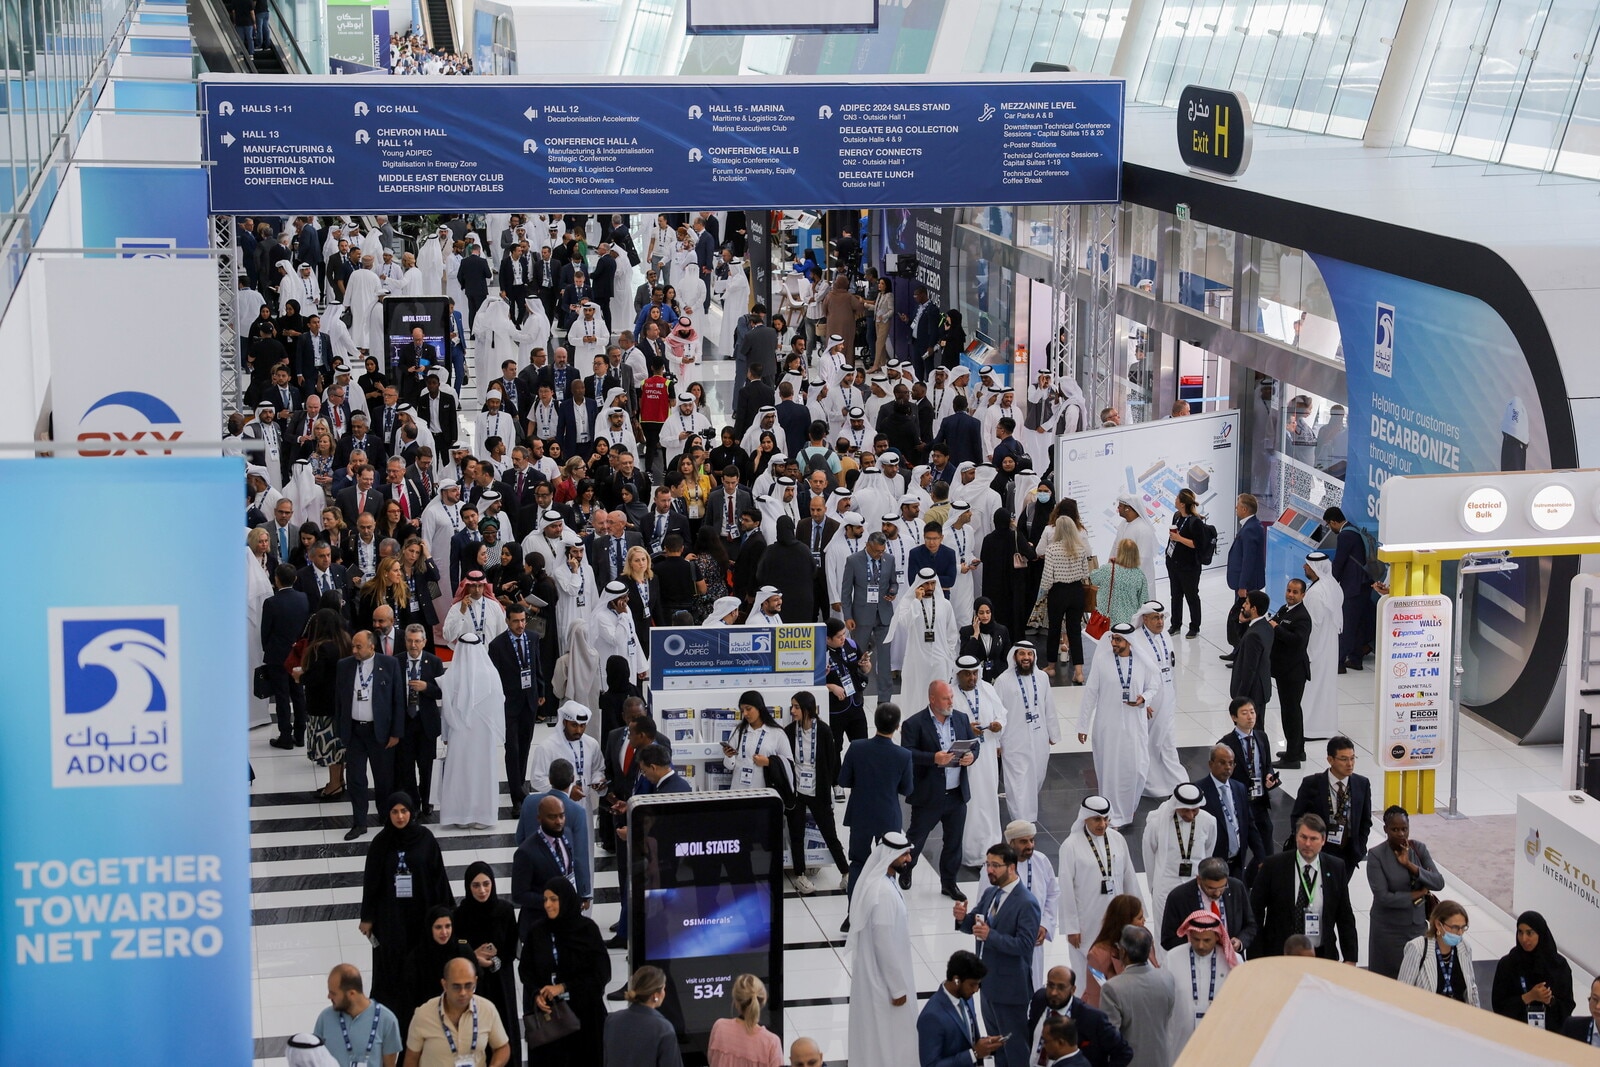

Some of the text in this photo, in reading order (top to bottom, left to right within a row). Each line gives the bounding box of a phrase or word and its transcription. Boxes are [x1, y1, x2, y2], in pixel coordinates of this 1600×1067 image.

[242, 105, 272, 113] HALLS
[1188, 98, 1210, 121] مخرج
[1192, 130, 1208, 154] Exit
[1215, 104, 1228, 158] H
[435, 160, 459, 168] Energy
[924, 235, 942, 256] BILLION
[926, 269, 941, 292] ZERO
[1376, 360, 1390, 372] ADNOC
[1372, 392, 1460, 440] Helping our customers
[77, 431, 184, 457] OXY
[1370, 414, 1460, 472] DECARBONIZE
[1369, 442, 1412, 474] through our
[1467, 501, 1502, 510] Electrical
[778, 628, 812, 638] SHOW
[778, 640, 812, 649] DAILIES
[1410, 710, 1438, 719] ERCON
[66, 752, 168, 774] ADNOC
[689, 839, 740, 856] OIL STATES
[14, 855, 222, 890] TOGETHER
[1542, 864, 1600, 908] INTERNATIONAL
[15, 890, 223, 928] TOWARDS
[16, 926, 224, 966] NET ZERO
[693, 984, 724, 999] 534
